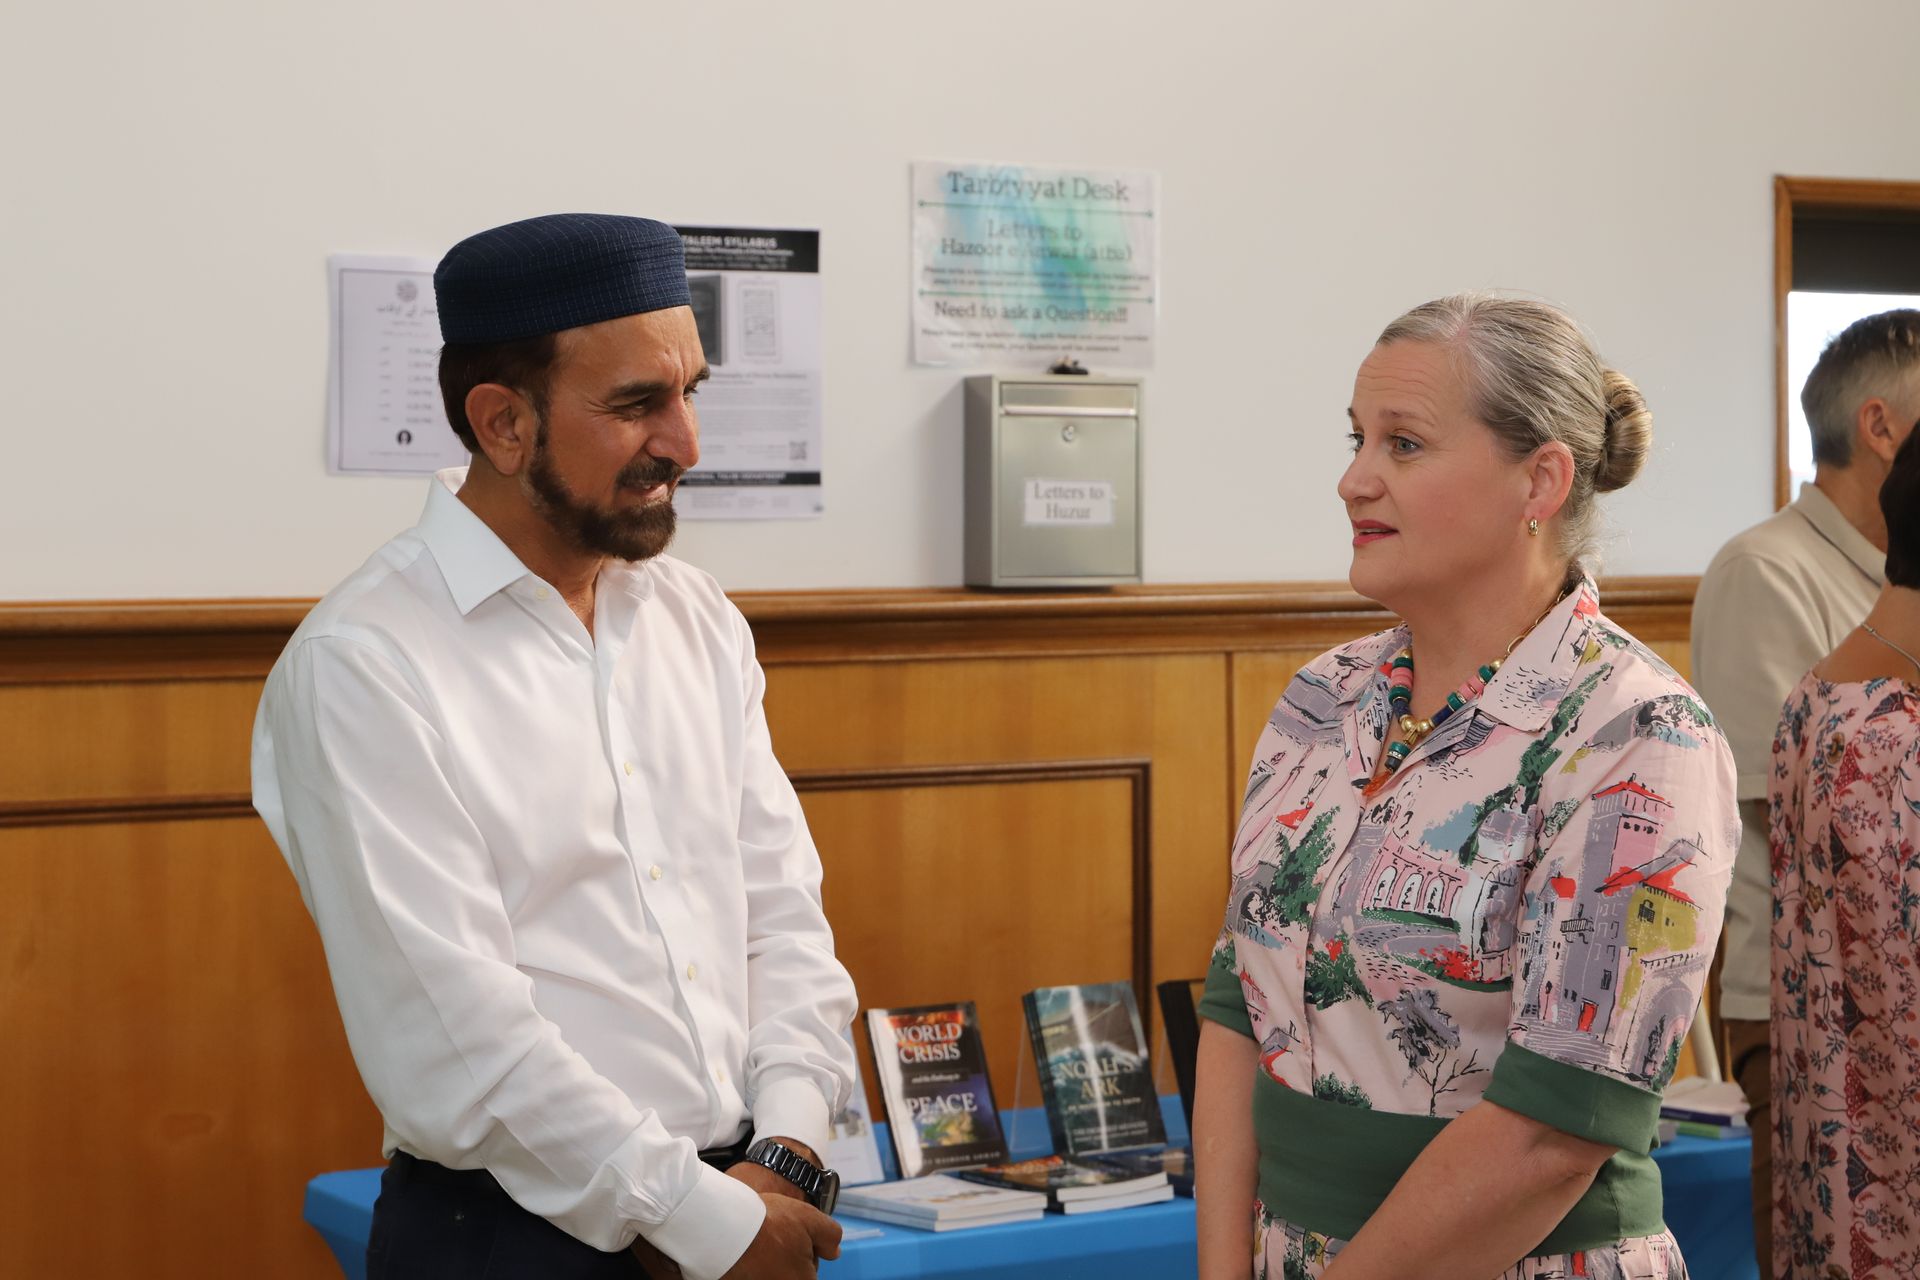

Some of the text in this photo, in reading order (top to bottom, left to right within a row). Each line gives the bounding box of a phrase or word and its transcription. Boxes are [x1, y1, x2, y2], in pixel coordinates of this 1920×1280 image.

[1072, 177, 1130, 201] Desk
[987, 218, 1082, 241] Letters to
[724, 235, 778, 249] SYLLABUS
[941, 237, 1002, 256] Hazoor
[934, 301, 976, 318] Need
[981, 304, 997, 319] to
[1001, 303, 1028, 319] ask
[1032, 307, 1042, 319] a
[1034, 482, 1104, 499] Letters to
[1046, 503, 1091, 519] Huzur
[893, 1022, 962, 1042] WORLD
[900, 1042, 961, 1064] CRISIS
[1081, 1077, 1121, 1099] ARK
[906, 1092, 978, 1115] PEACE
